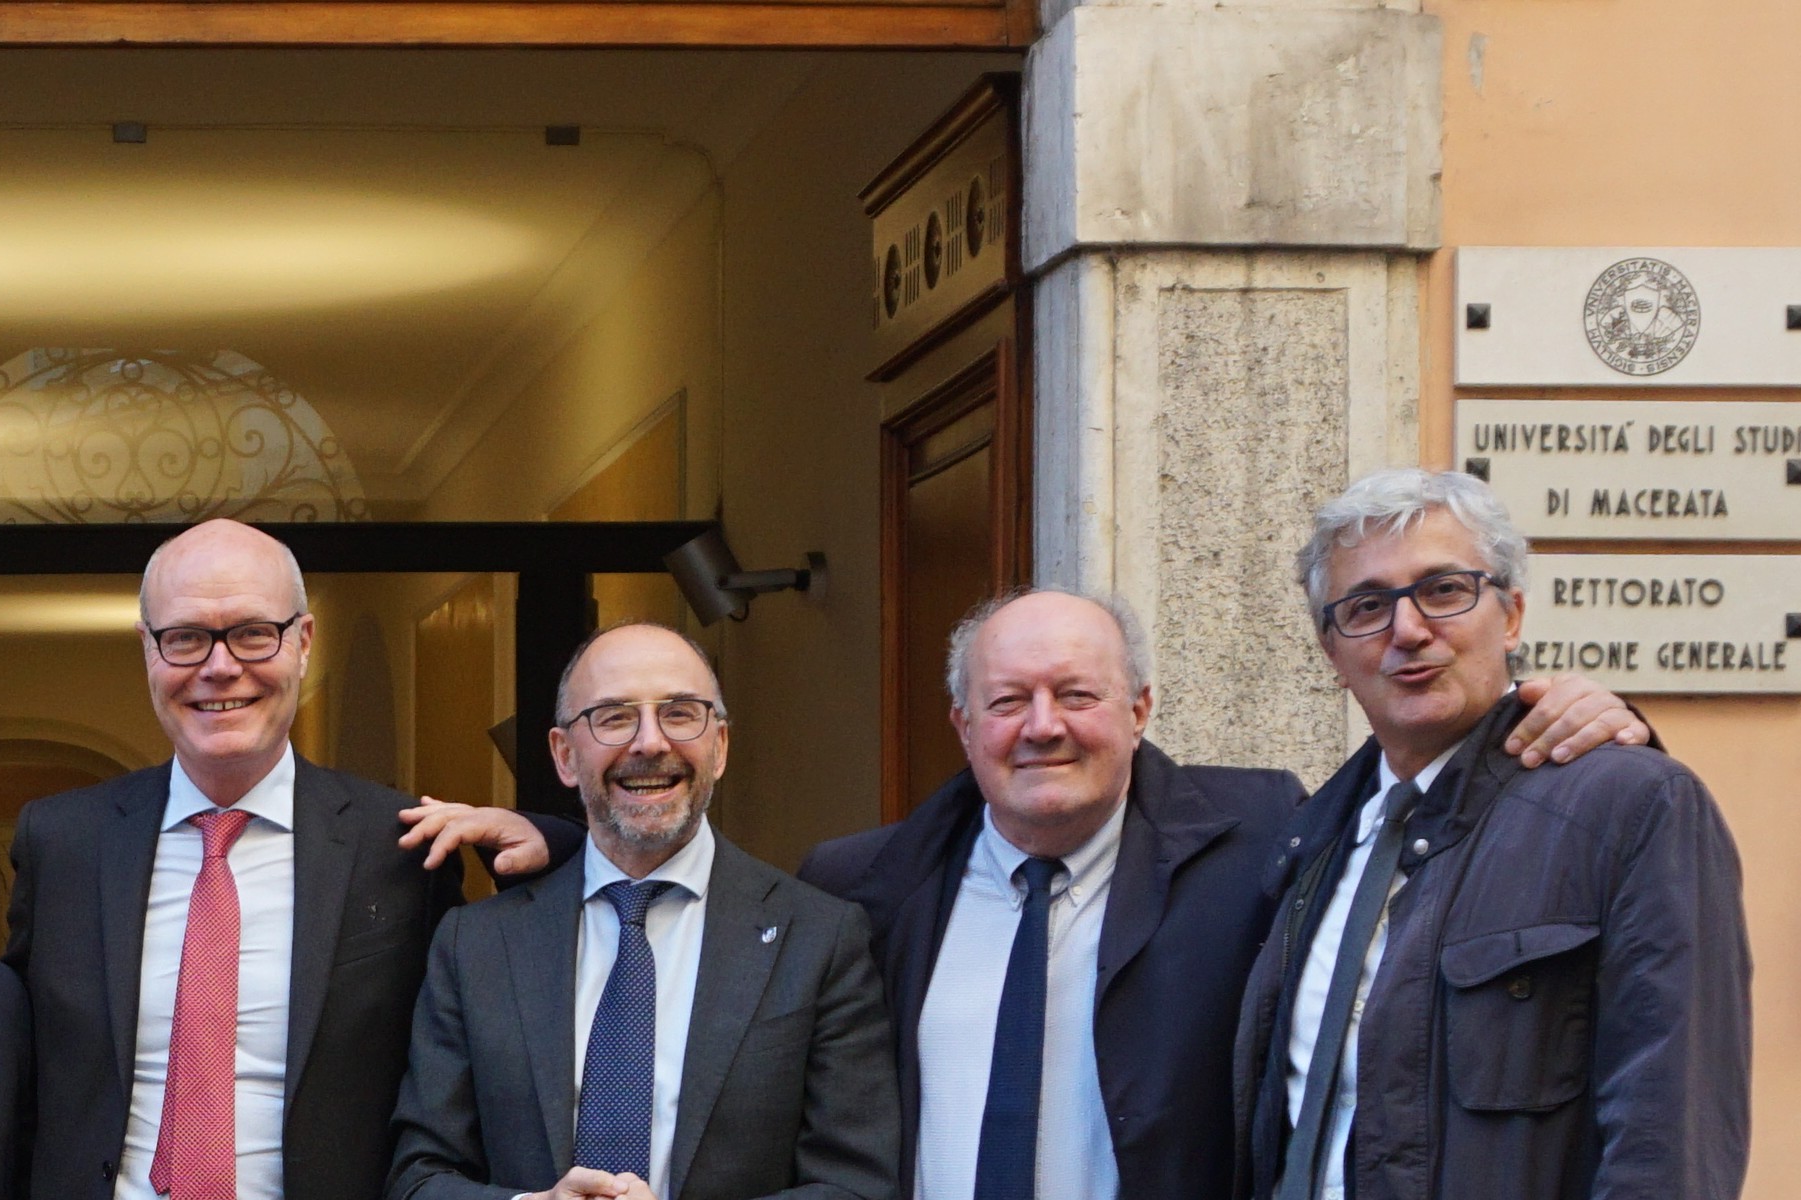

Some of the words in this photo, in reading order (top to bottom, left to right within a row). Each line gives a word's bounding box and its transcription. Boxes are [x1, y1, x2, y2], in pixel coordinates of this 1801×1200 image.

[1649, 424, 1714, 453] DEGLI
[1548, 488, 1569, 516] DI
[1591, 489, 1728, 517] MACERATA
[1554, 578, 1724, 607] RETTORATO
[1519, 641, 1640, 670] REZIONE
[1657, 641, 1787, 670] GENERALE
